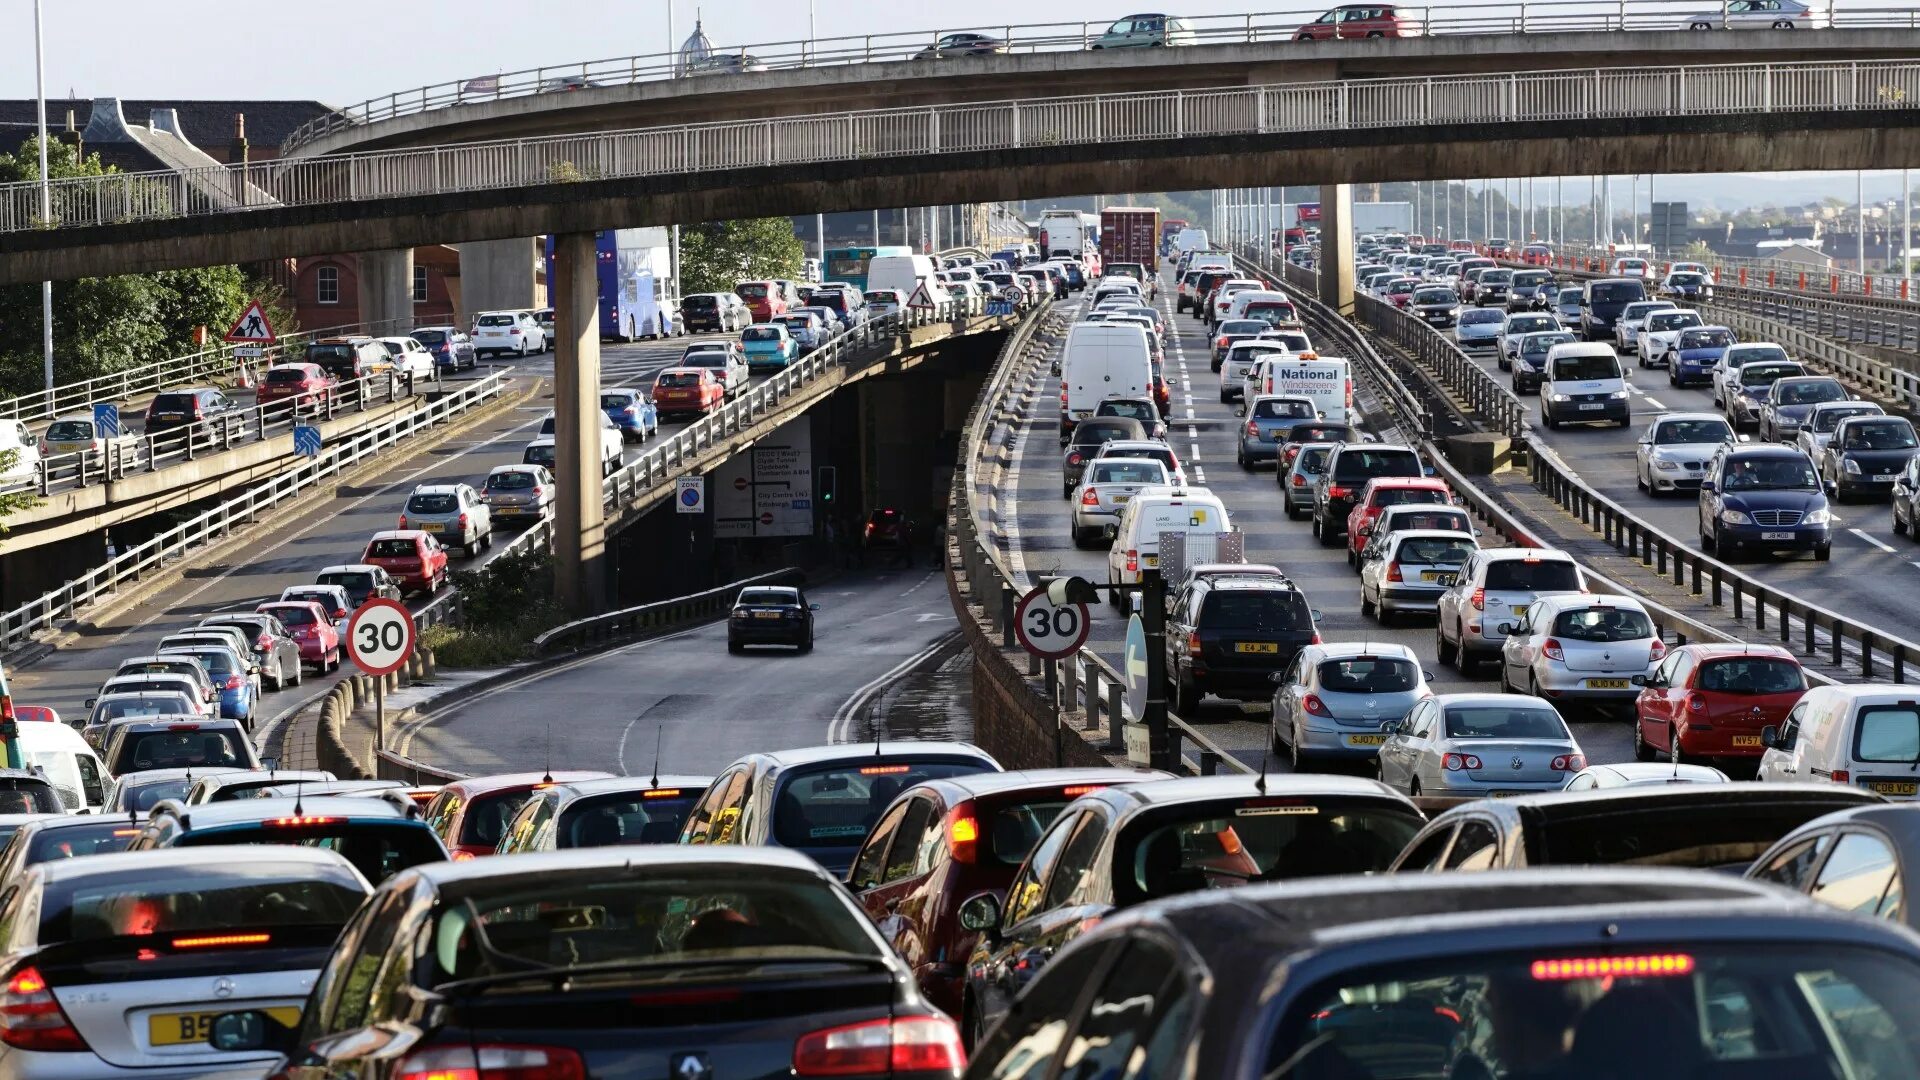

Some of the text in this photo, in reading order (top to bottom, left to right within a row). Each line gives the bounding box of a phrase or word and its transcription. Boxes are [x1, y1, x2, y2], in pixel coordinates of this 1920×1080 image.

[1006, 291, 1020, 301] 50
[1281, 369, 1337, 379] National
[1281, 381, 1337, 389] Windscreens
[1028, 608, 1077, 637] 30
[358, 620, 404, 653] 30
[1244, 644, 1255, 652] E4
[1128, 734, 1139, 752] One
[1352, 735, 1374, 744] SJ07
[1736, 736, 1758, 744] NV57
[1869, 783, 1915, 793] NC08 VCF
